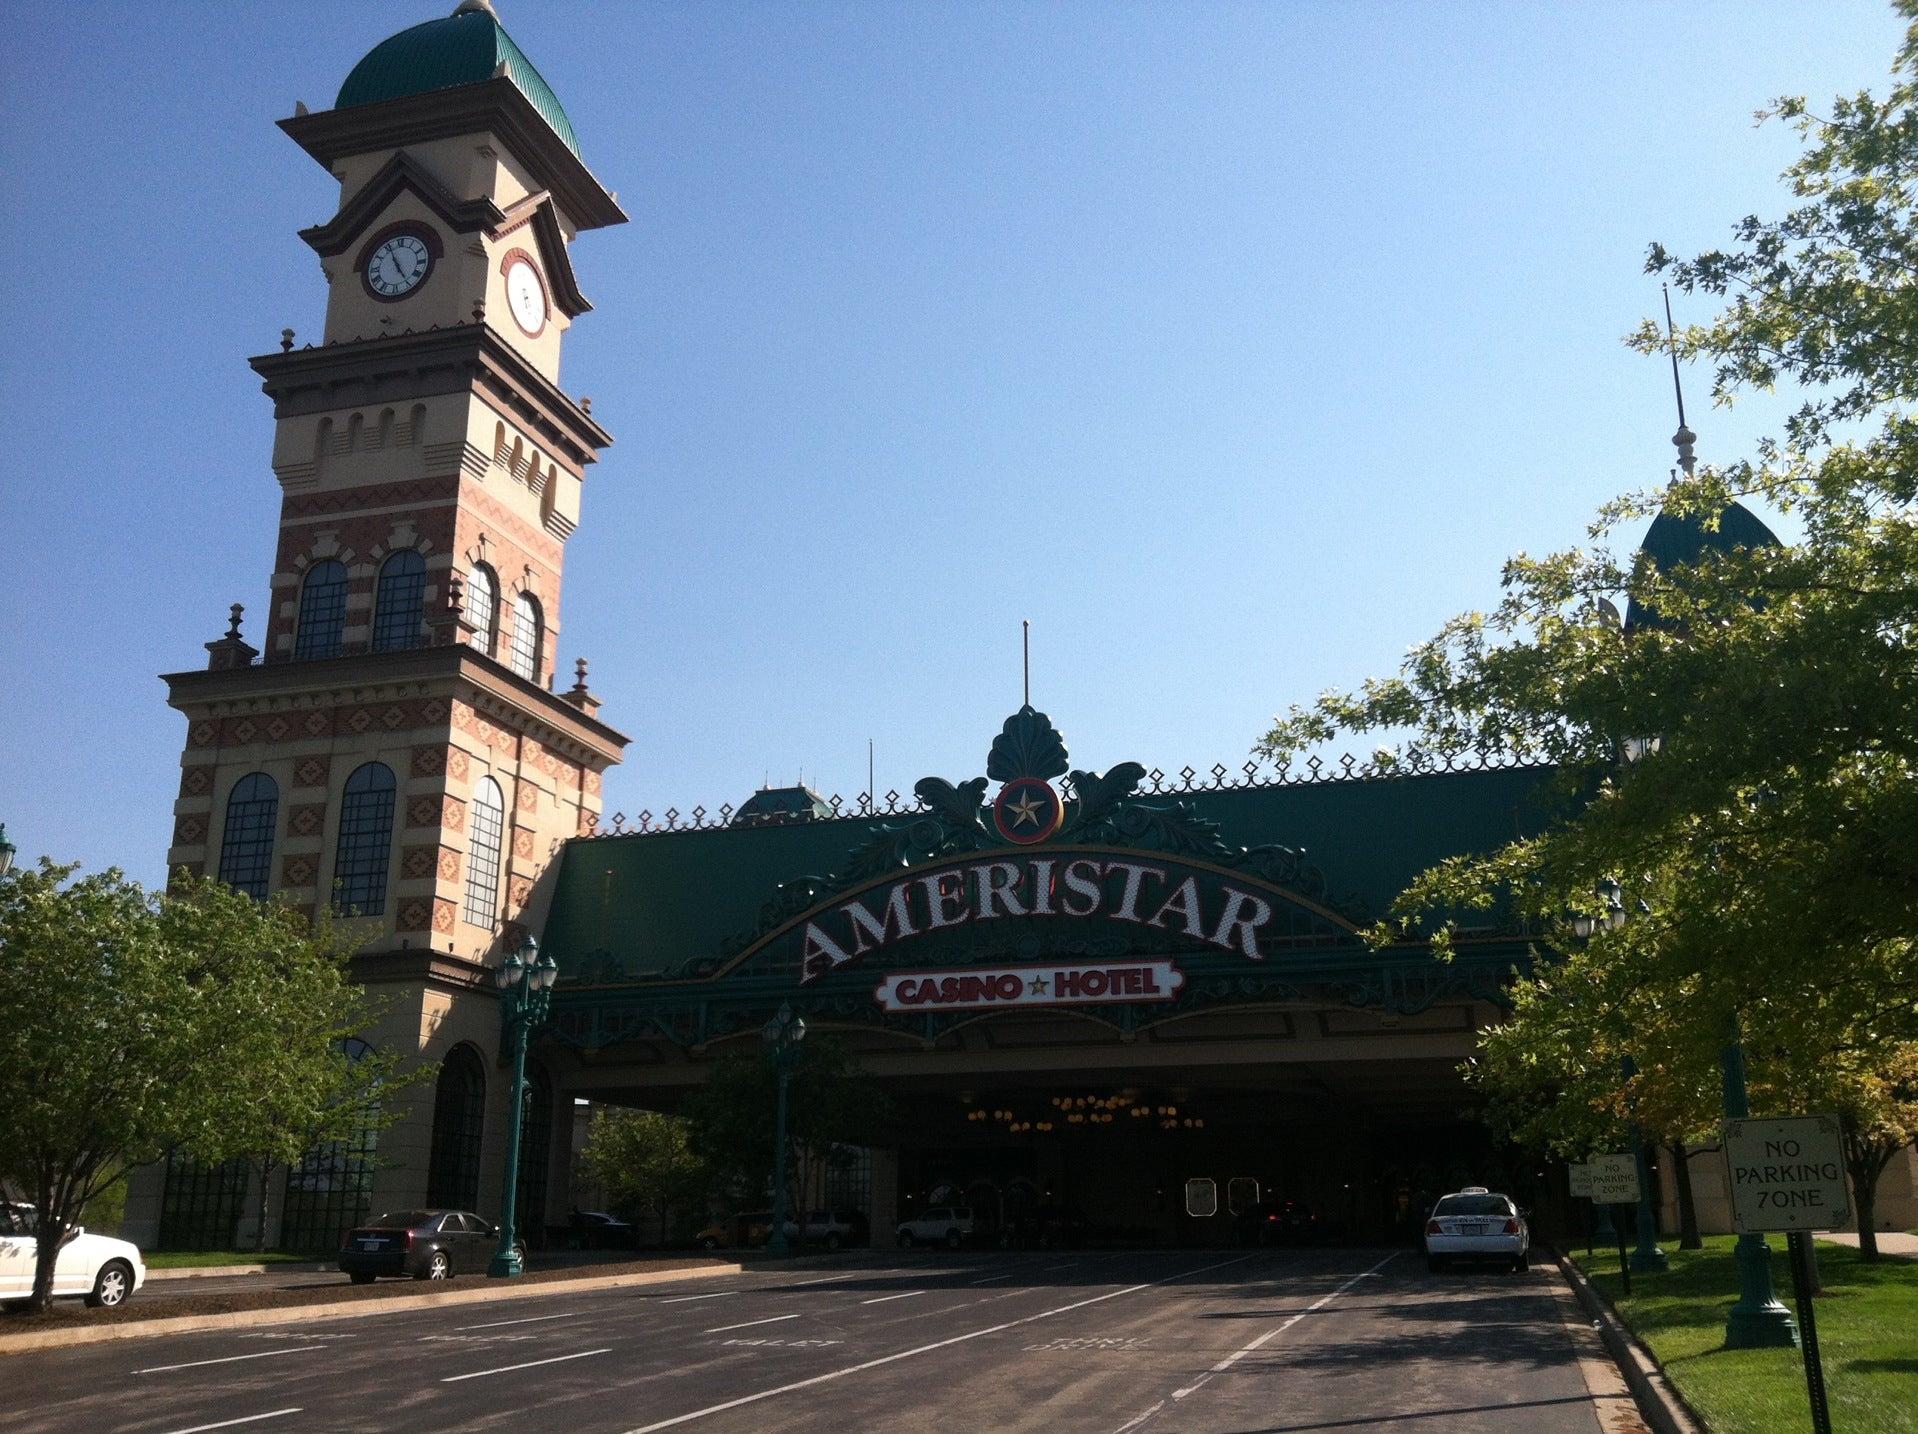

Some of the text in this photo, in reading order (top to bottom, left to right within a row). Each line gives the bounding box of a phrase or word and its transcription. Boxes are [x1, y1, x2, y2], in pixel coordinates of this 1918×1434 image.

[800, 858, 1274, 984] AMERISTAR
[894, 967, 1161, 1005] CASINO HOTEL
[1765, 1140, 1800, 1157] NO
[1605, 1164, 1620, 1172] NO
[1735, 1163, 1838, 1184] PARKING
[1592, 1174, 1635, 1184] PARKING
[1602, 1185, 1629, 1193] ZONE
